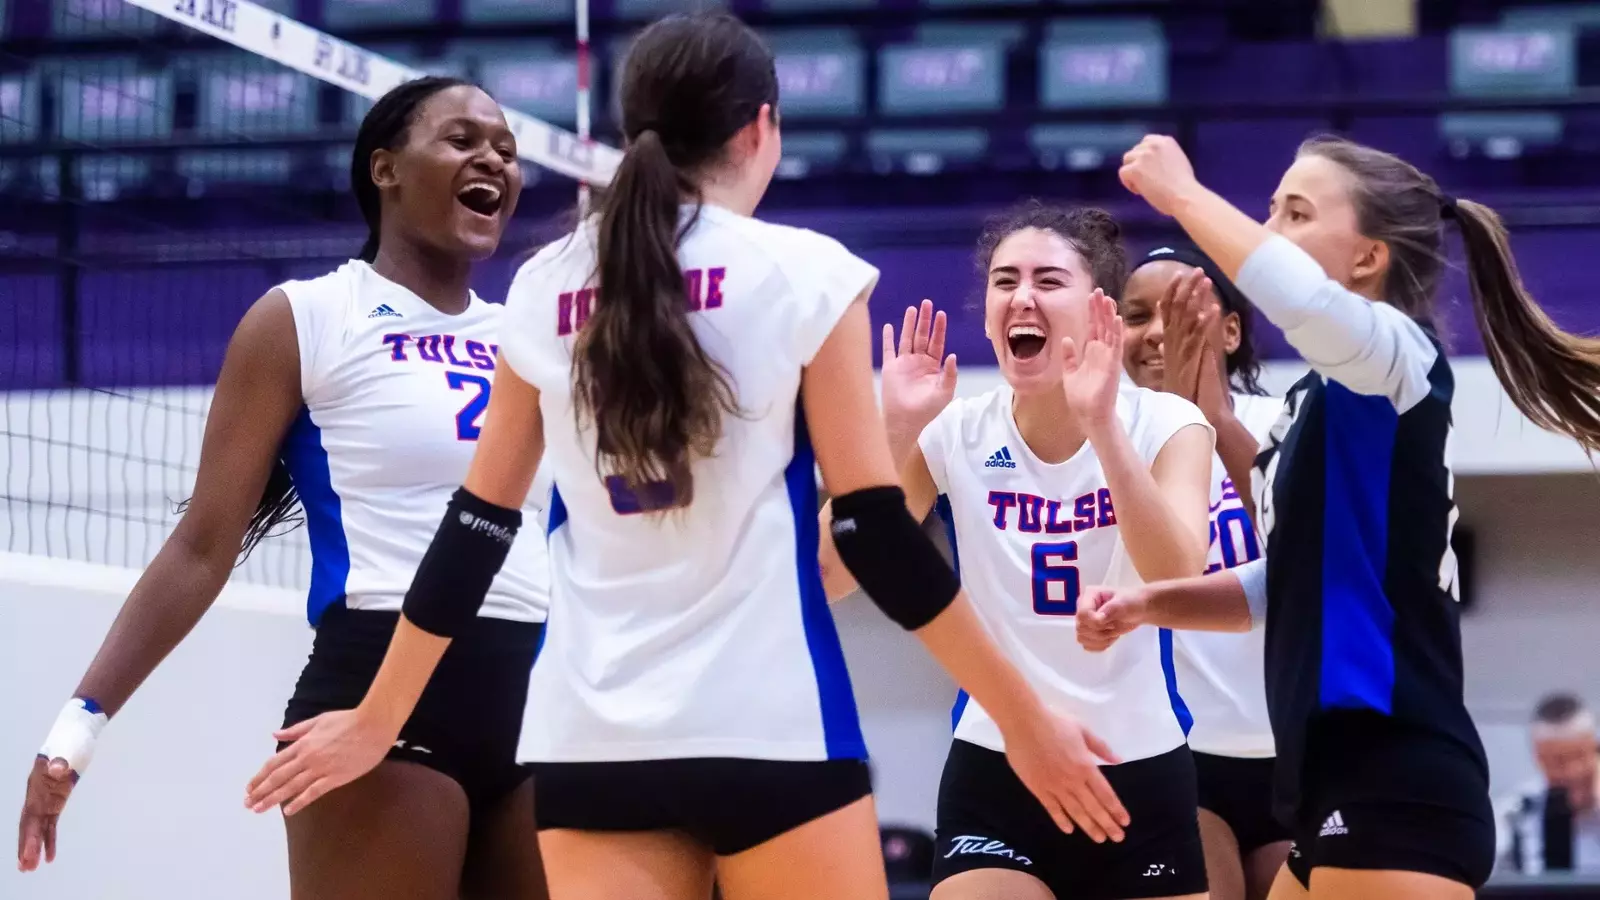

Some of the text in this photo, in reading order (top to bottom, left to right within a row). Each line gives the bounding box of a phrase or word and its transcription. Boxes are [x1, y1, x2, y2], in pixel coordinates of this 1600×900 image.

[383, 333, 499, 371] TULS
[445, 371, 492, 441] 2
[985, 459, 1016, 468] adidas
[1031, 540, 1080, 616] 6
